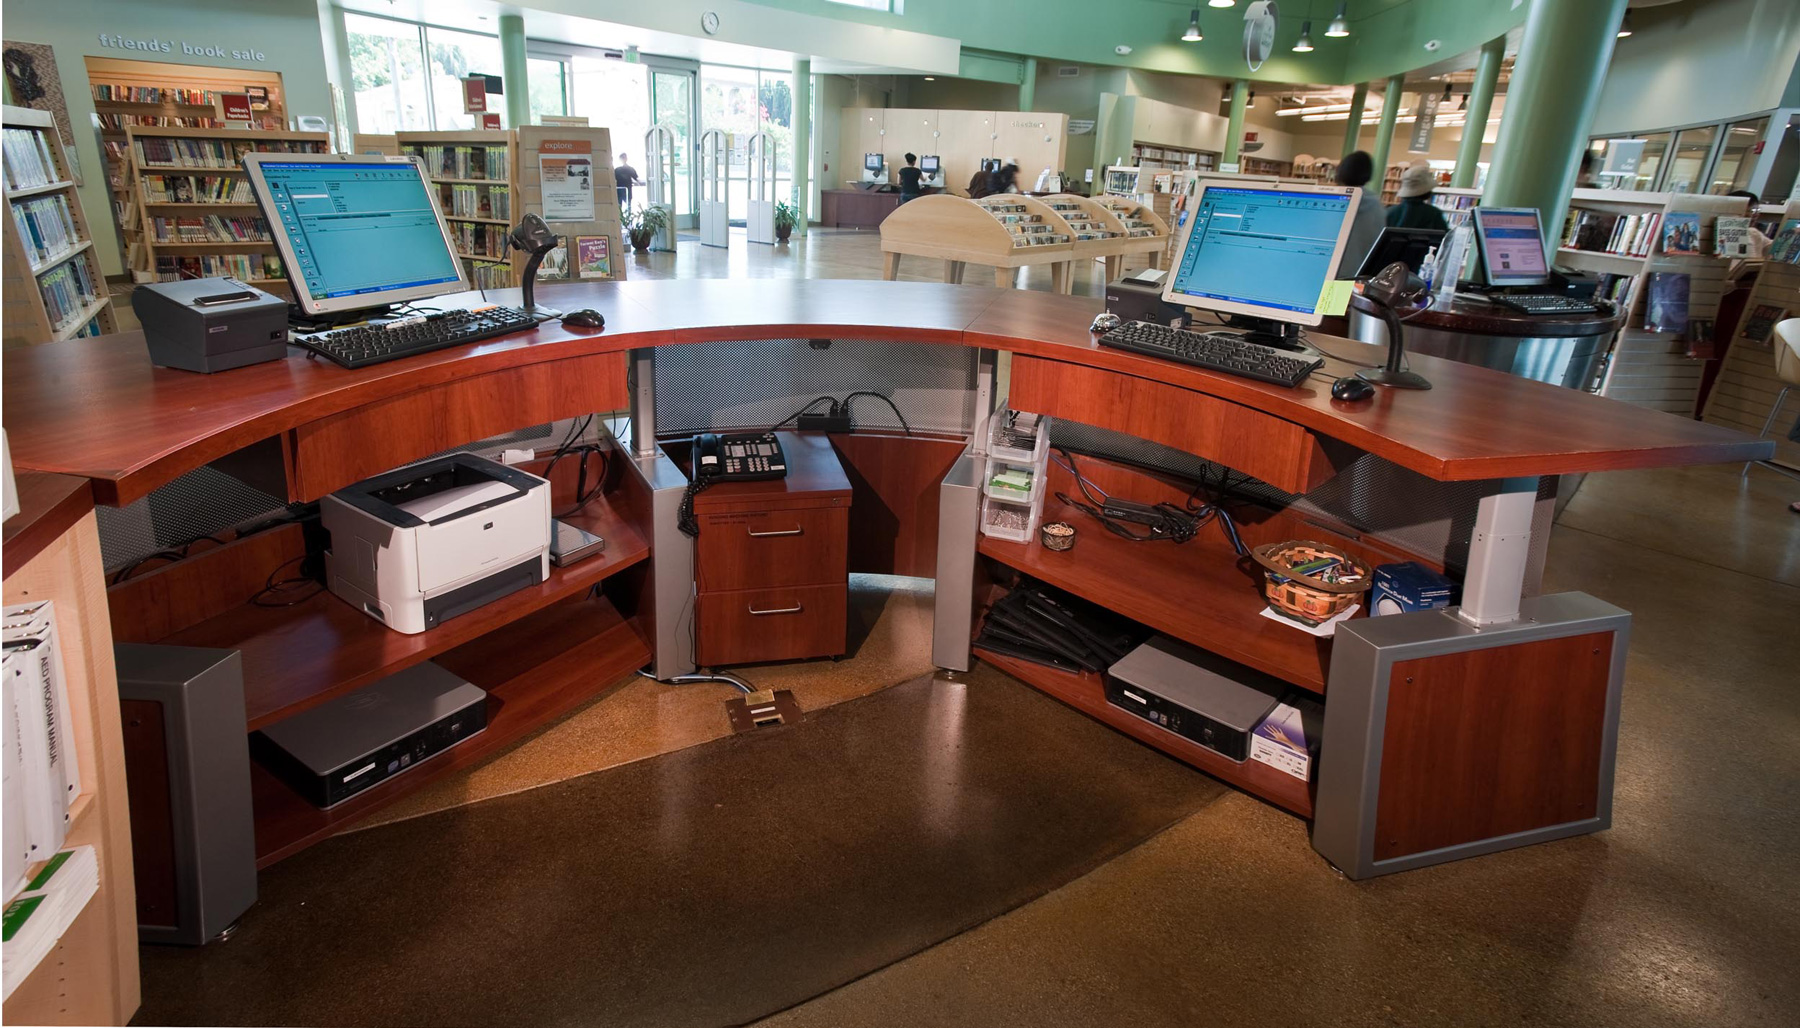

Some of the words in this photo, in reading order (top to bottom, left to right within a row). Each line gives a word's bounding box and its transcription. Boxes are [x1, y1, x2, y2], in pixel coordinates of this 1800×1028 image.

[99, 34, 175, 53] friends'
[181, 41, 226, 58] book
[232, 49, 266, 62] sale
[1415, 93, 1436, 147] language
[544, 142, 573, 150] explore
[40, 656, 50, 677] AED
[43, 677, 54, 728] PROGRAM
[48, 727, 58, 768] MANUAL
